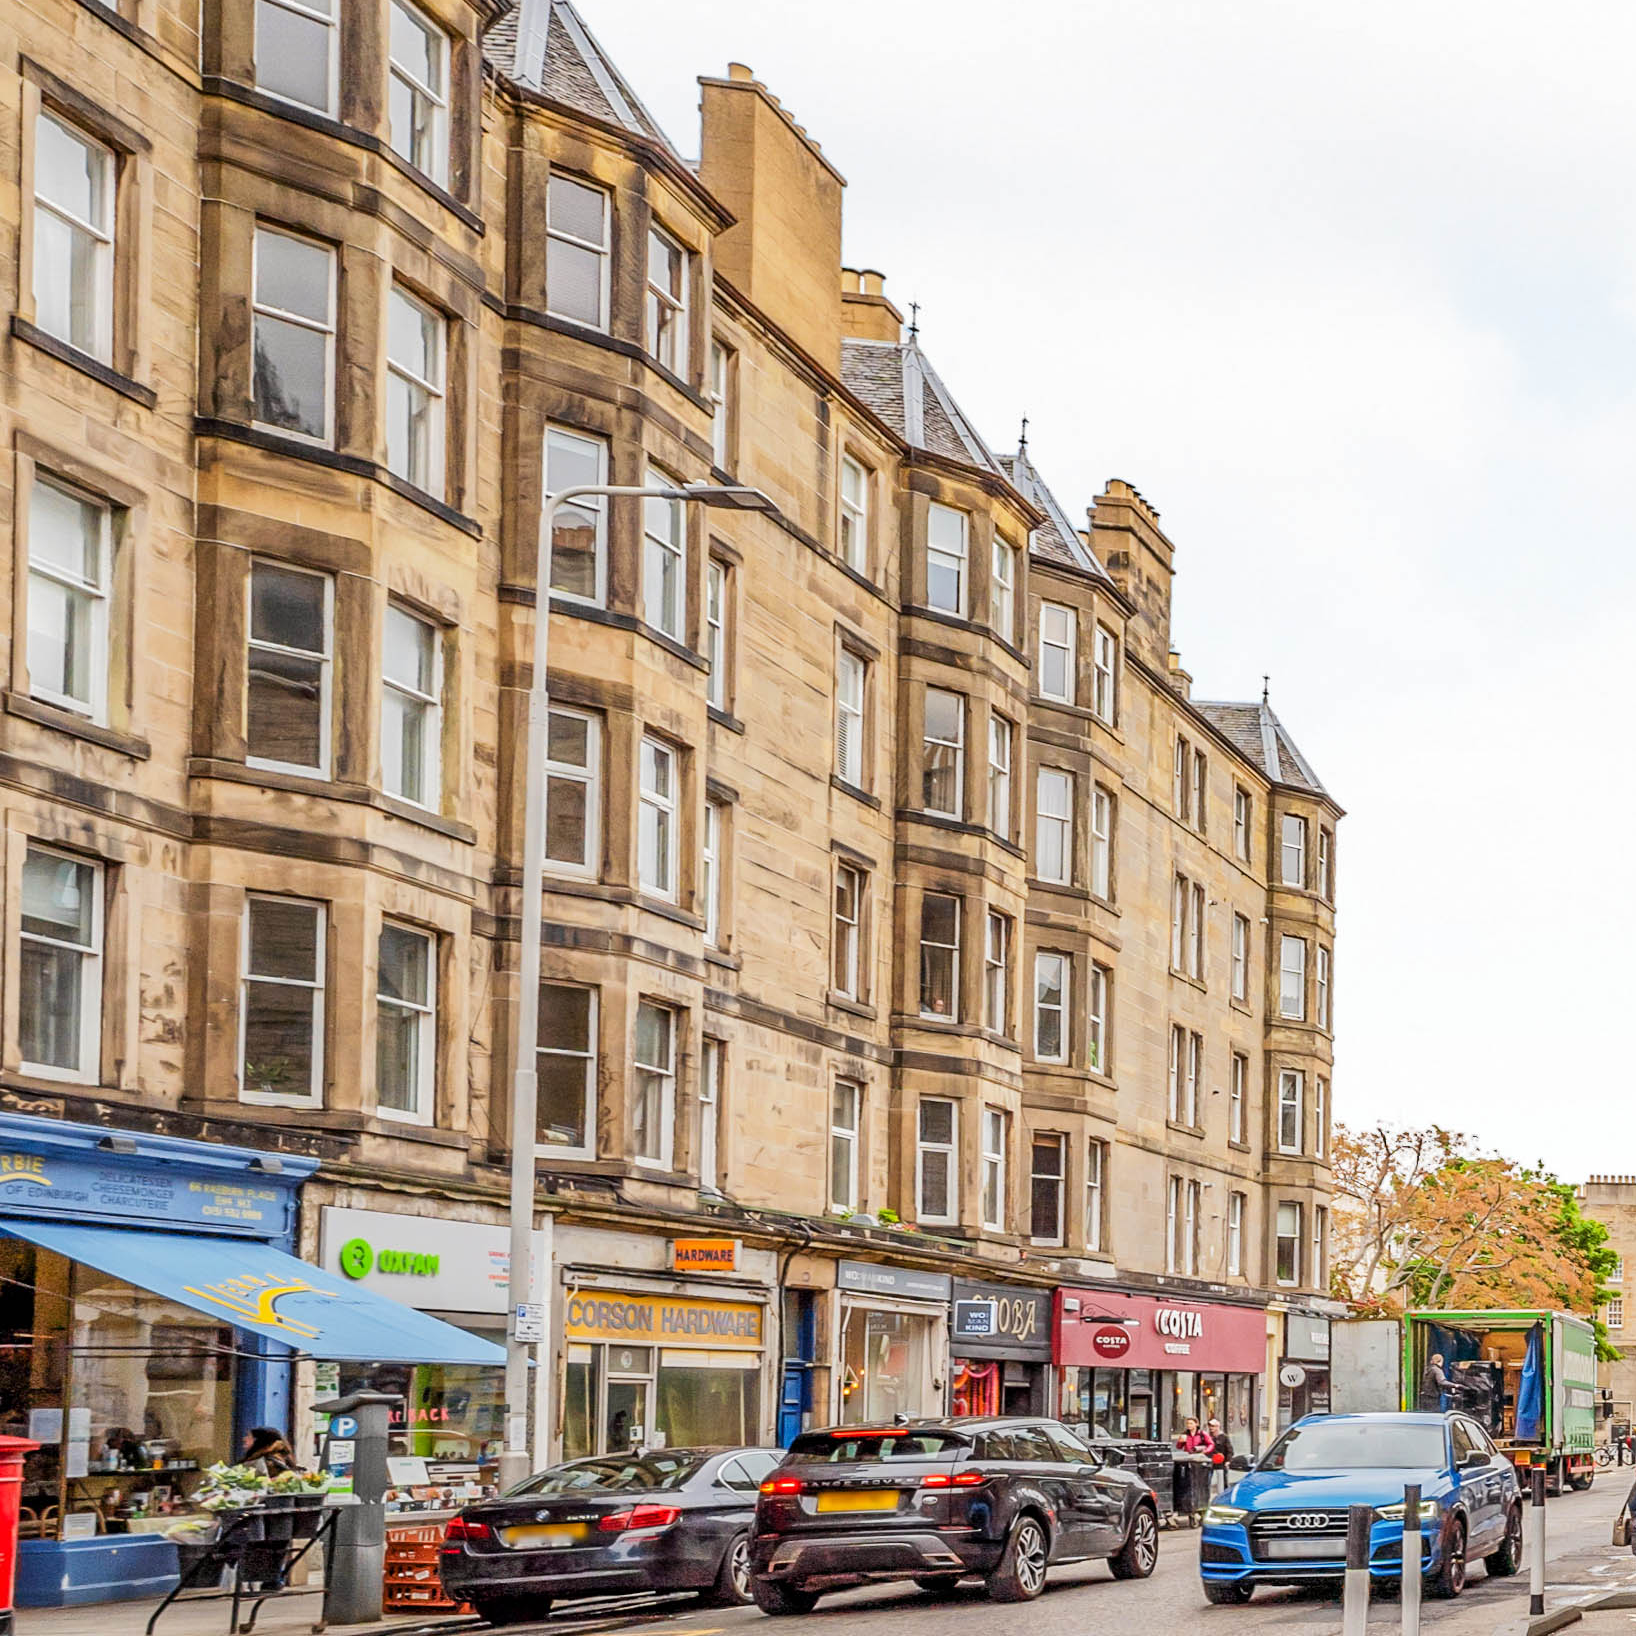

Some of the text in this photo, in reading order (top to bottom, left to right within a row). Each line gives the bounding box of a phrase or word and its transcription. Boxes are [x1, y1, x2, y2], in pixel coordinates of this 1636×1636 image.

[6, 1184, 89, 1203] OF EDINBURGH
[91, 1182, 175, 1199] CHEESEMONGER
[378, 1250, 440, 1276] OXFAM
[675, 1249, 734, 1262] HARDWARE
[567, 1299, 654, 1332] CORSON
[661, 1307, 759, 1337] HARDWARE
[1155, 1309, 1204, 1339] COSTA
[1096, 1336, 1127, 1345] COSTA
[1287, 1374, 1298, 1383] W
[408, 1407, 449, 1423] BACK
[337, 1417, 352, 1437] P
[800, 1477, 916, 1488] RANGE ROVER
